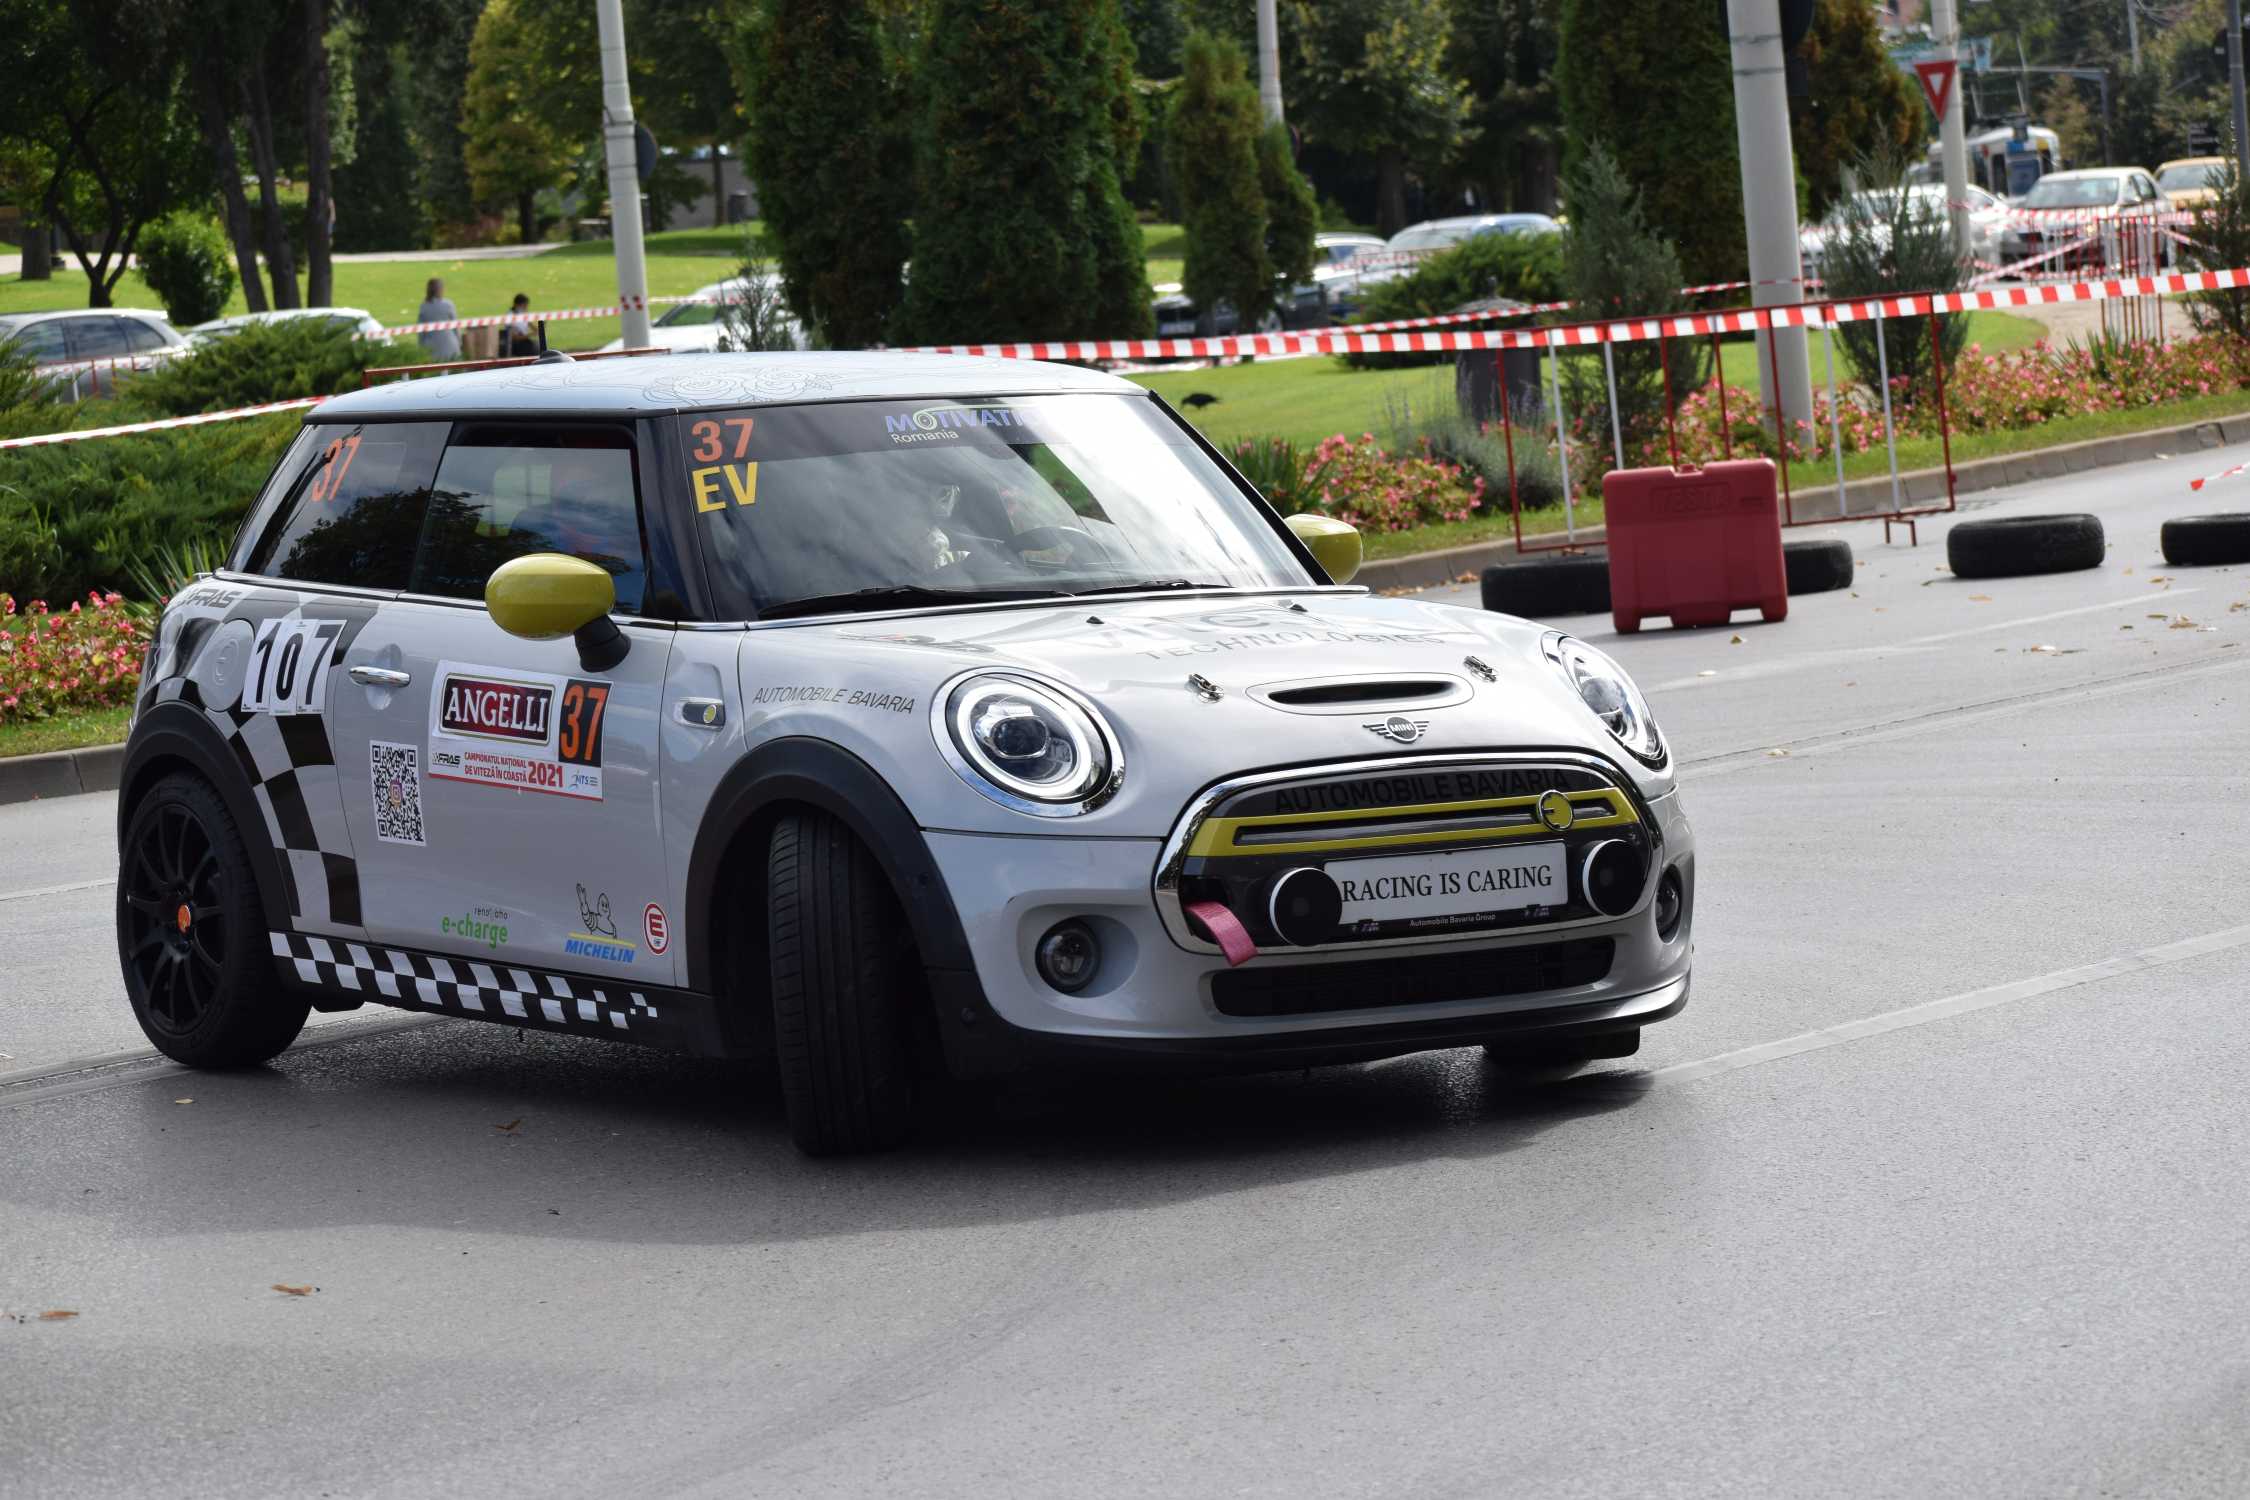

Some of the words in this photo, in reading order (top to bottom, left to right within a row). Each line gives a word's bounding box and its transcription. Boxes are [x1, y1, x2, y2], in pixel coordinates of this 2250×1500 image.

[885, 408, 1028, 433] MOTIVATI
[692, 417, 754, 462] 37
[891, 428, 960, 445] Romania
[311, 435, 362, 502] 37
[692, 461, 758, 514] EV
[1135, 630, 1445, 660] TECHNOLOGIES
[256, 621, 343, 705] 107
[445, 686, 549, 733] ANGELLI
[752, 686, 848, 705] AUTOMOBILE
[847, 690, 915, 714] BAVARIA
[560, 684, 608, 761] 37
[1389, 723, 1415, 732] MINI
[464, 751, 500, 765] CAMPIONATUL
[464, 765, 474, 776] DE
[528, 761, 564, 788] 2021
[1275, 774, 1452, 813] AUTOMOBILE
[1454, 768, 1570, 799] BAVARIA
[1341, 873, 1433, 902] RACING
[1439, 872, 1461, 895] IS
[1467, 865, 1553, 893] CARING
[441, 913, 508, 949] e-charge
[1449, 914, 1475, 925] Bavaria
[1475, 912, 1496, 922] Group
[564, 938, 636, 964] MICHELIN
